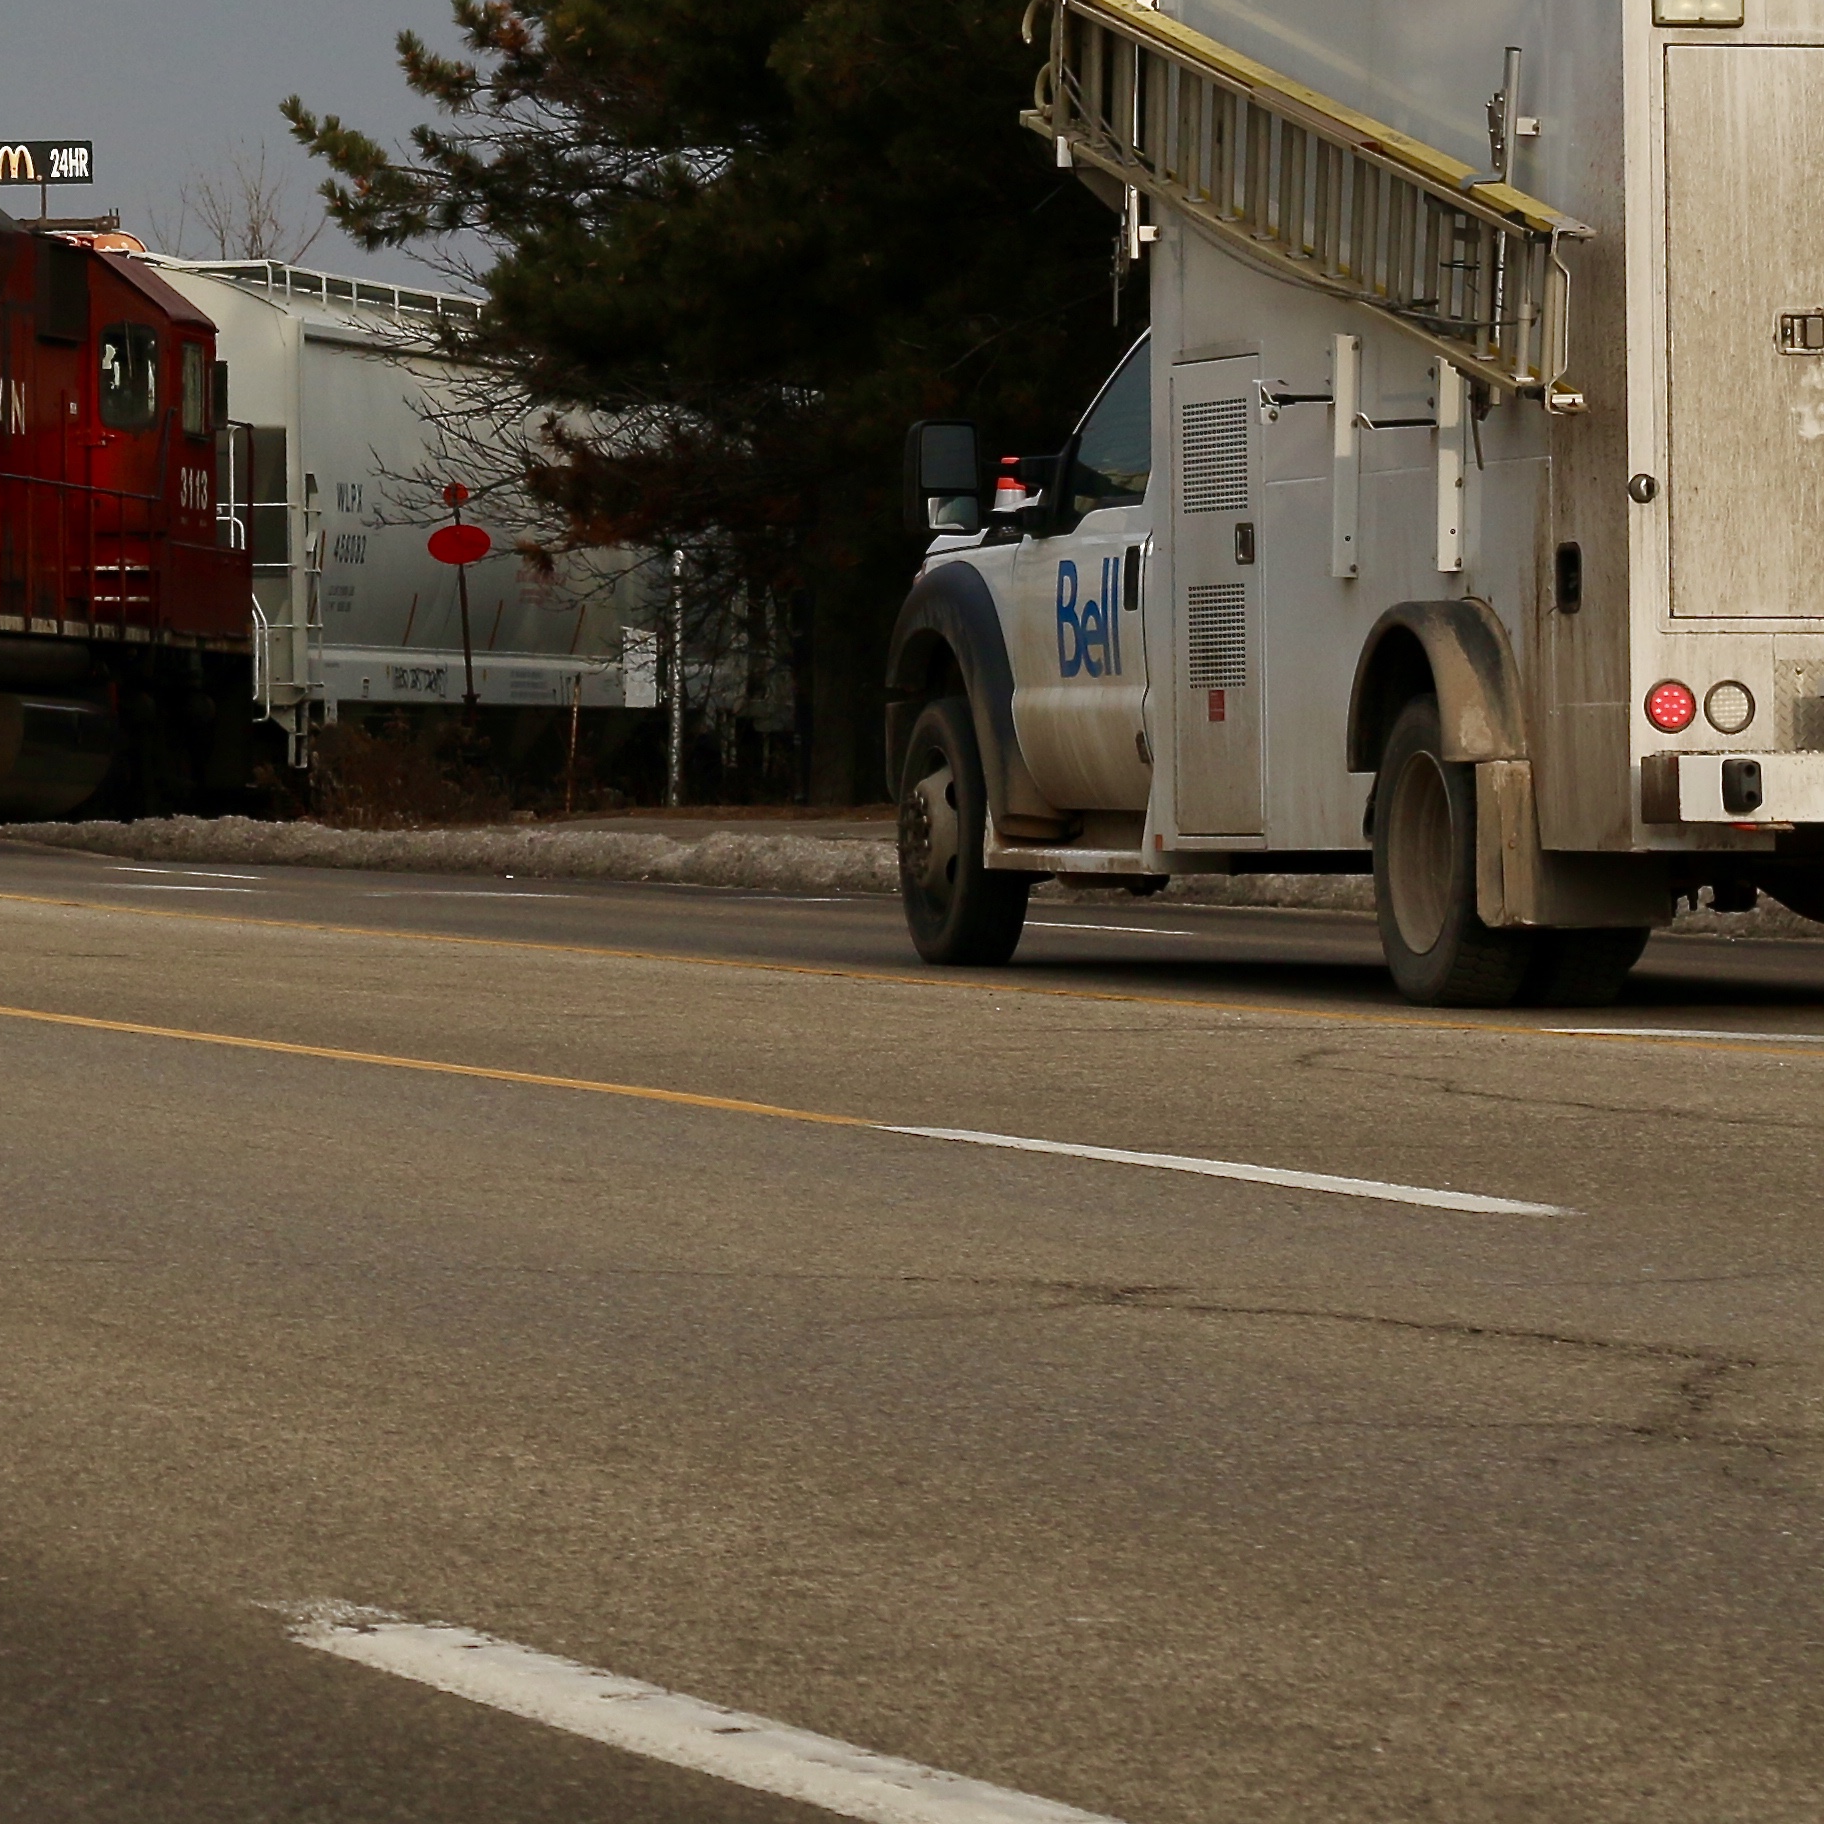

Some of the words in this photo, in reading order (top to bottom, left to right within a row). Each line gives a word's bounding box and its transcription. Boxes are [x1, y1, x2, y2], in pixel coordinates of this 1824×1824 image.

[49, 147, 89, 179] 24HR
[180, 466, 208, 511] 3113
[1056, 556, 1122, 678] Bell
